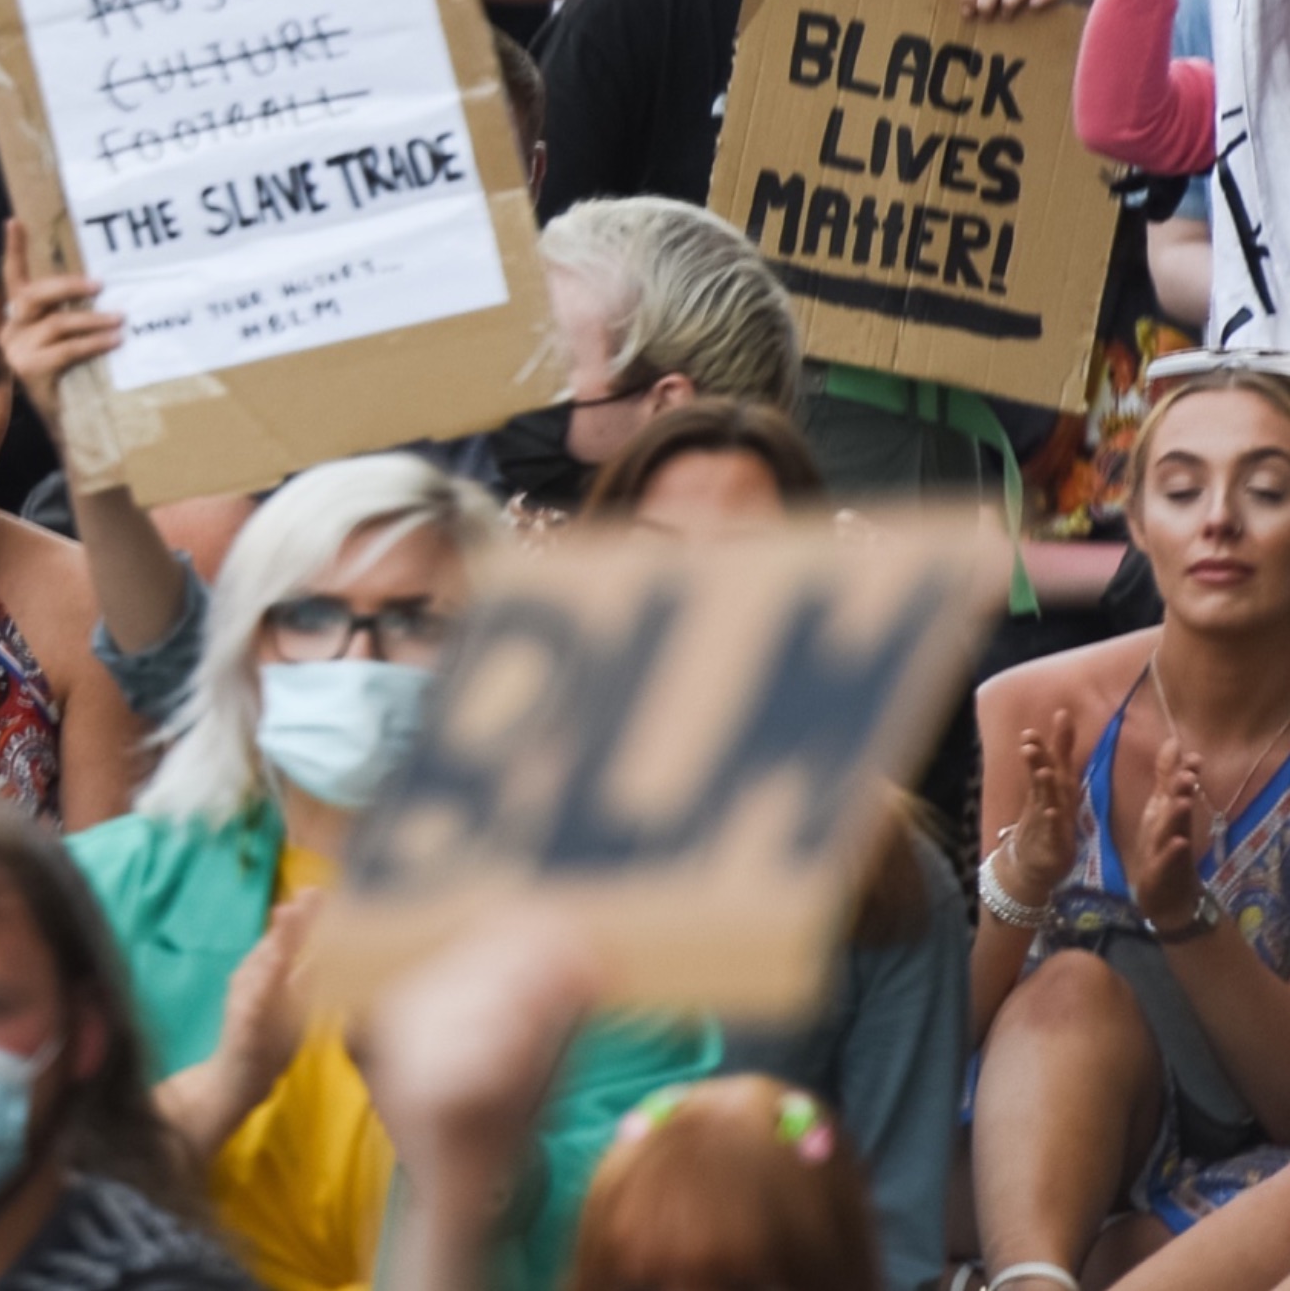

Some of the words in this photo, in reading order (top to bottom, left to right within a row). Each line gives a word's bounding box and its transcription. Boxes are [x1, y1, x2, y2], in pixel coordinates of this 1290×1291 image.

[99, 12, 351, 113] CULTURE
[789, 10, 1027, 121] BLACK
[97, 87, 367, 174] FOOTBALL
[820, 108, 1026, 206] LIVES
[85, 200, 182, 253] THE
[200, 160, 329, 238] SLAVE
[325, 131, 467, 211] TRADE
[746, 168, 1016, 296] MATTER!
